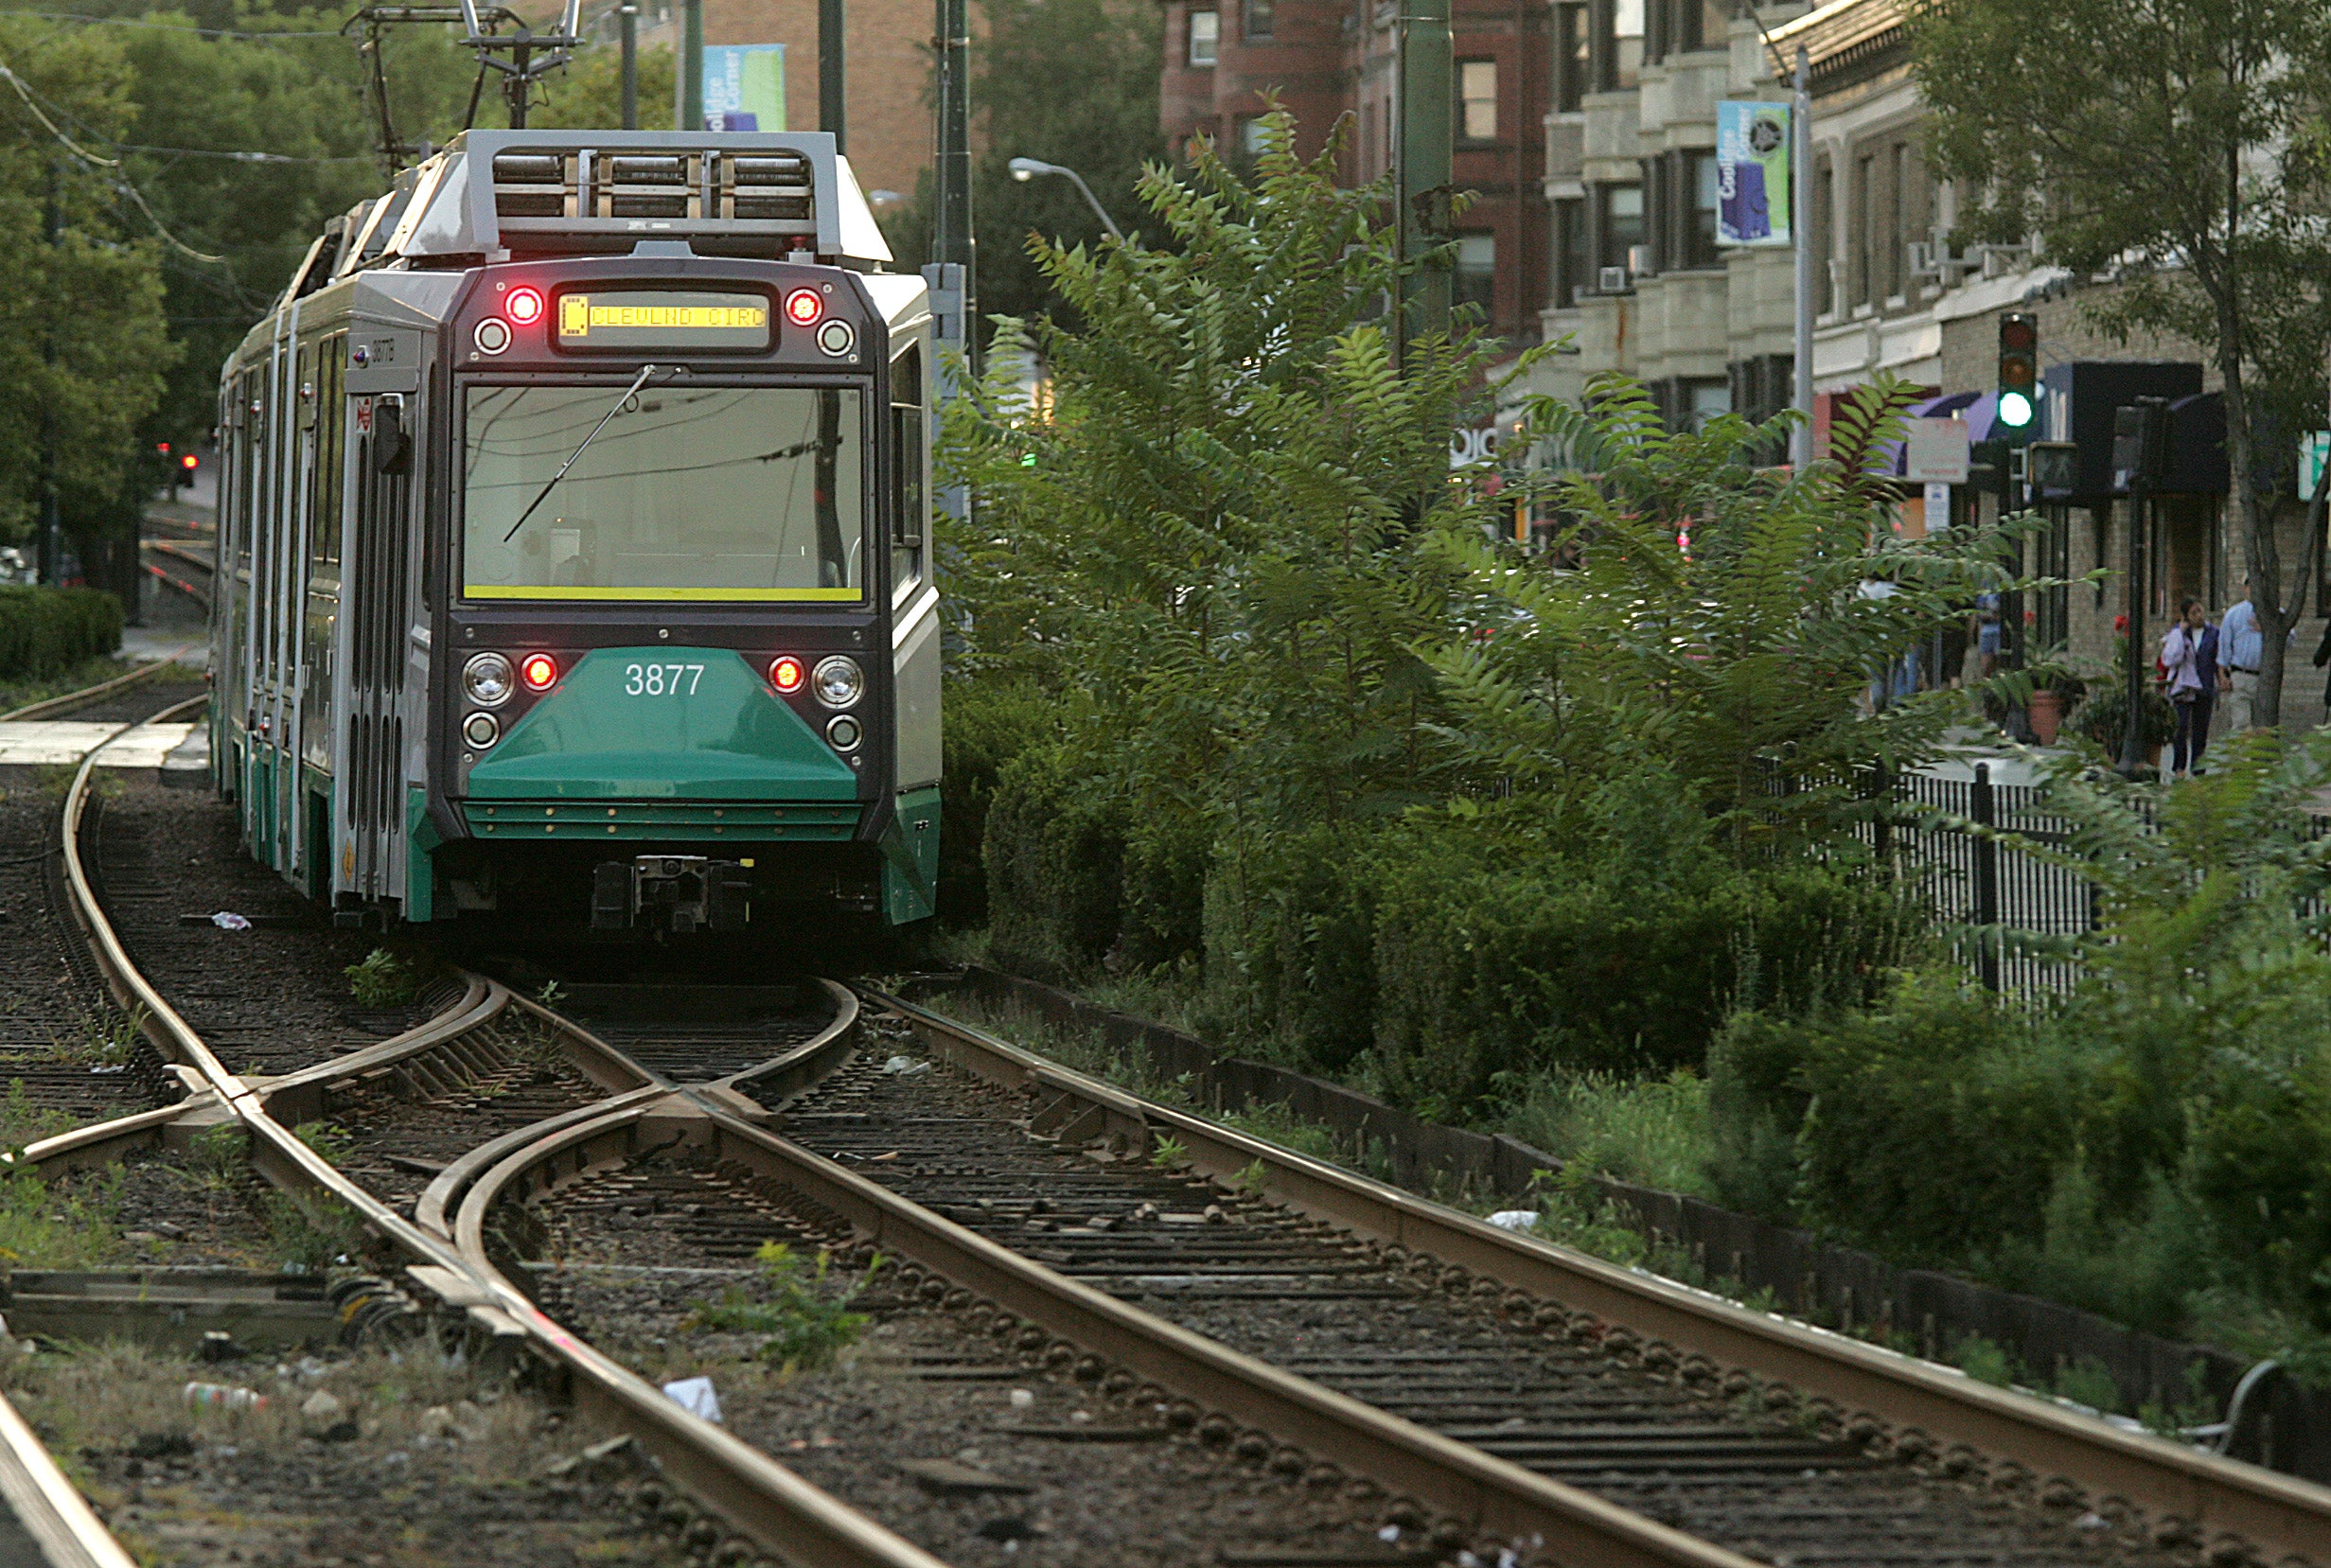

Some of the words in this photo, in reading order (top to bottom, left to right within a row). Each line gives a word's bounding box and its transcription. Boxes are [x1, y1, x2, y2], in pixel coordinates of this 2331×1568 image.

[1718, 129, 1737, 201] Coolidge
[592, 308, 692, 326] CLEVLND
[708, 308, 766, 326] CIRC
[625, 663, 705, 696] 3877
